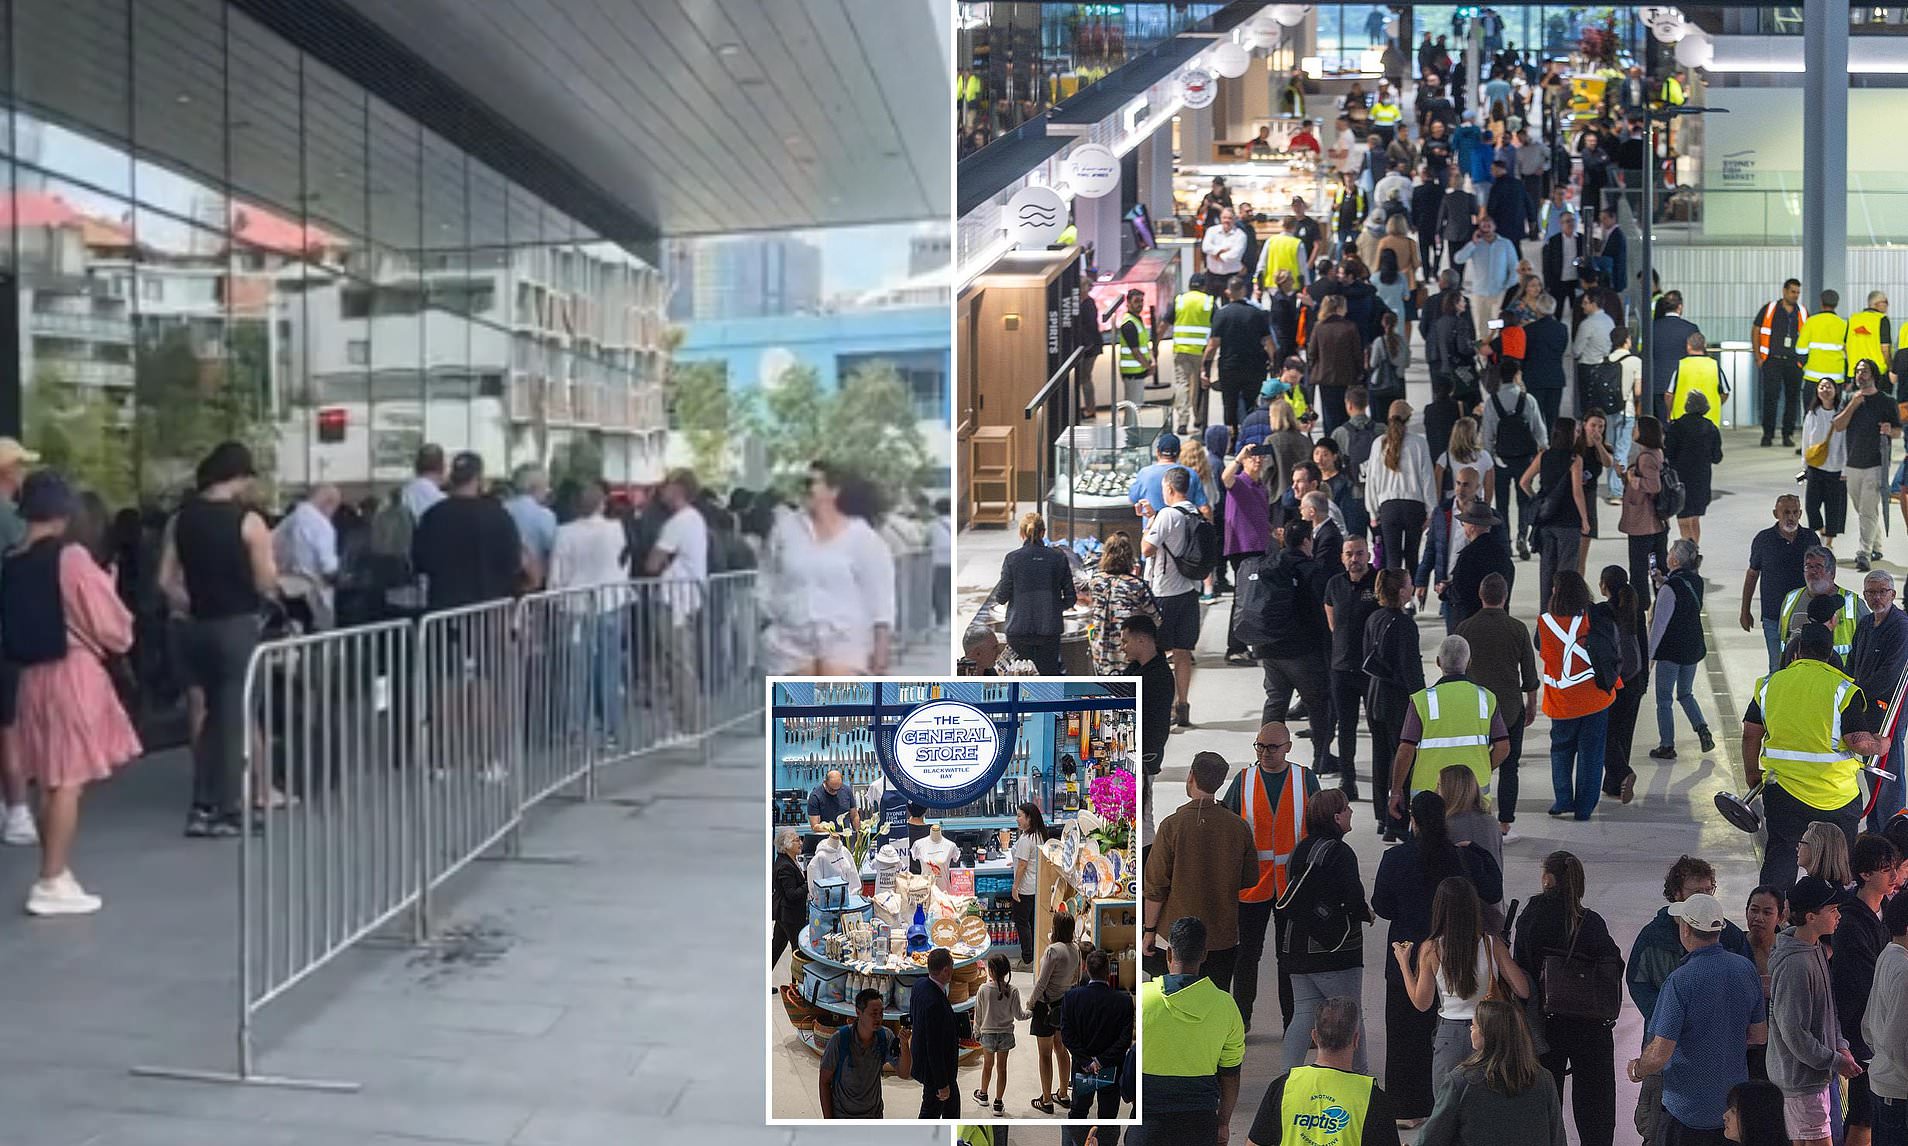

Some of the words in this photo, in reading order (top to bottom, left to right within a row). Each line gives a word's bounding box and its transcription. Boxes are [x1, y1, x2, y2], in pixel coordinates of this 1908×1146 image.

[1062, 296, 1072, 328] WINE
[1049, 310, 1059, 354] SPIRITS
[933, 715, 960, 725] THE
[901, 727, 992, 745] GENERAL
[915, 745, 979, 761] STORE
[1310, 1094, 1336, 1103] ANOTHER
[1293, 1113, 1338, 1130] raptis
